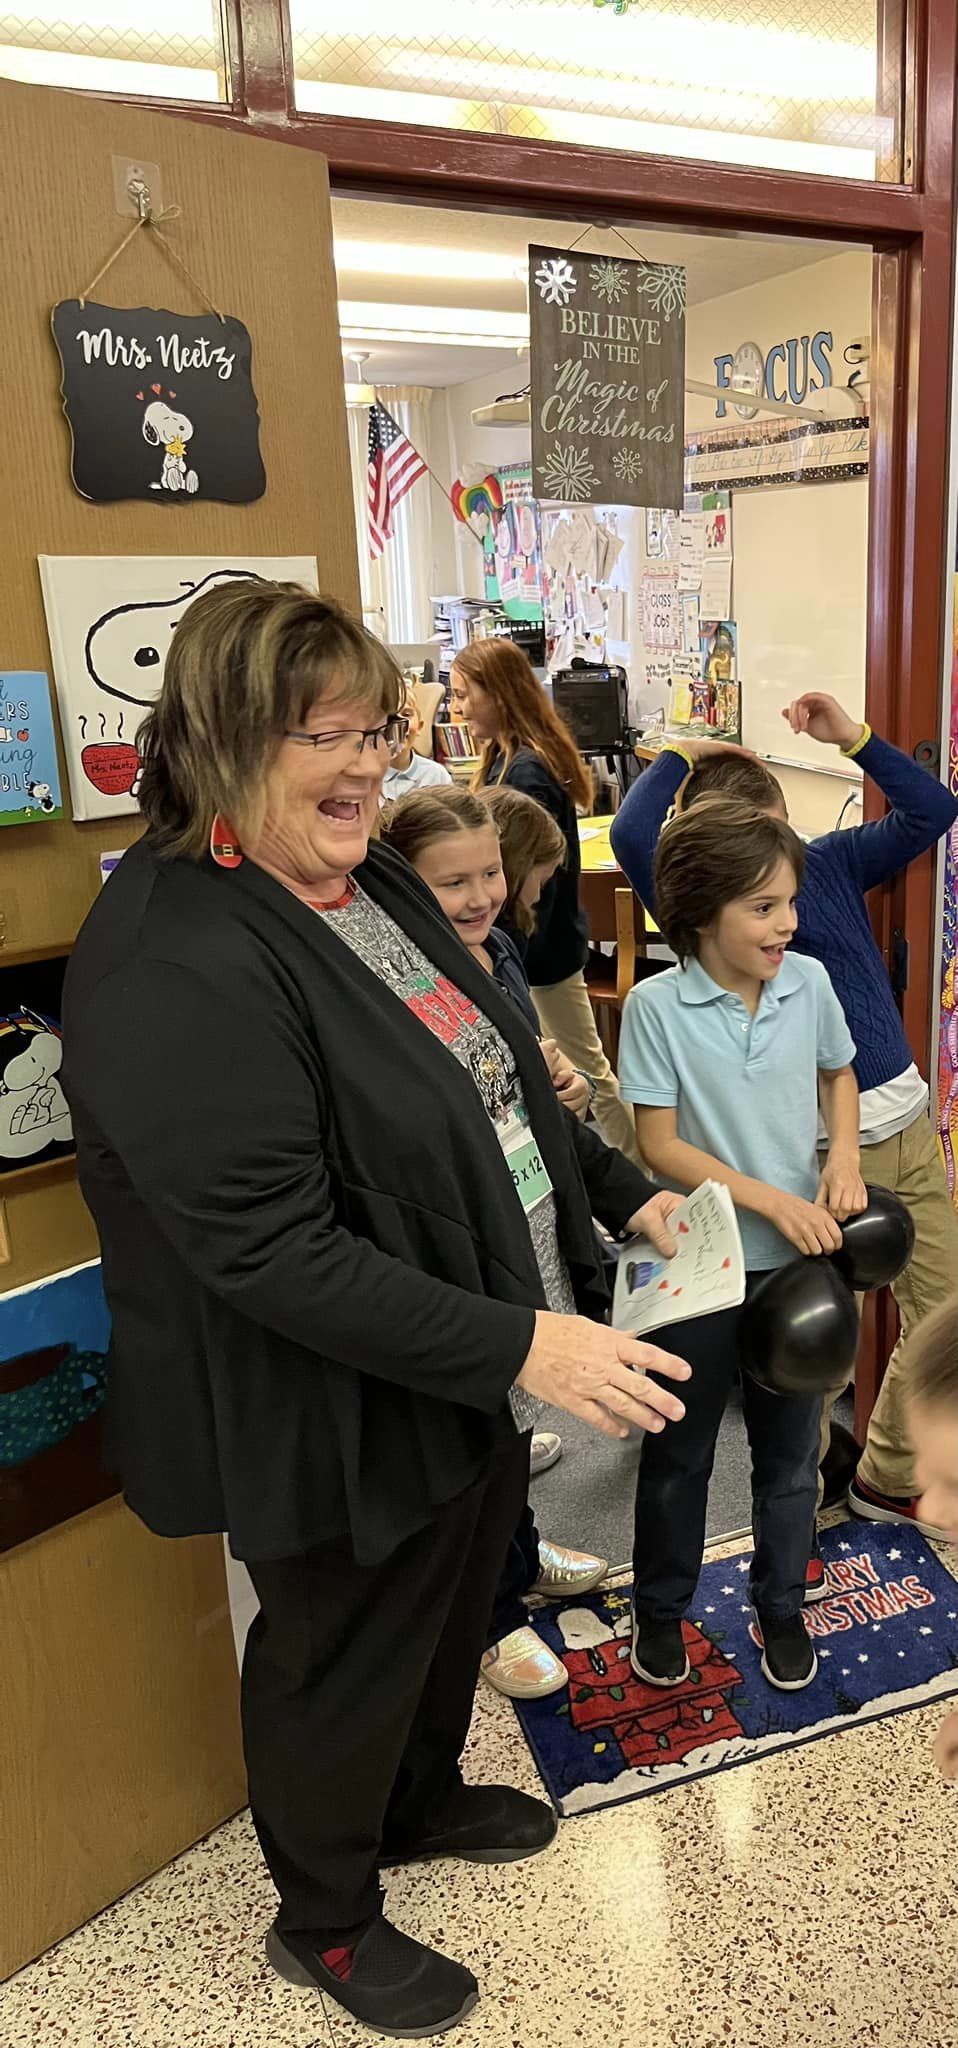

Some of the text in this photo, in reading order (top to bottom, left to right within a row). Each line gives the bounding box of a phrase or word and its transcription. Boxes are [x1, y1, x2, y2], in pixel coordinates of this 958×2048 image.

[560, 308, 661, 345] BELIEVE
[76, 328, 235, 380] Mrs. Neetz
[583, 341, 640, 365] IN THE
[553, 358, 669, 414] Magic of
[540, 394, 675, 444] Christmas
[528, 1155, 542, 1175] 12
